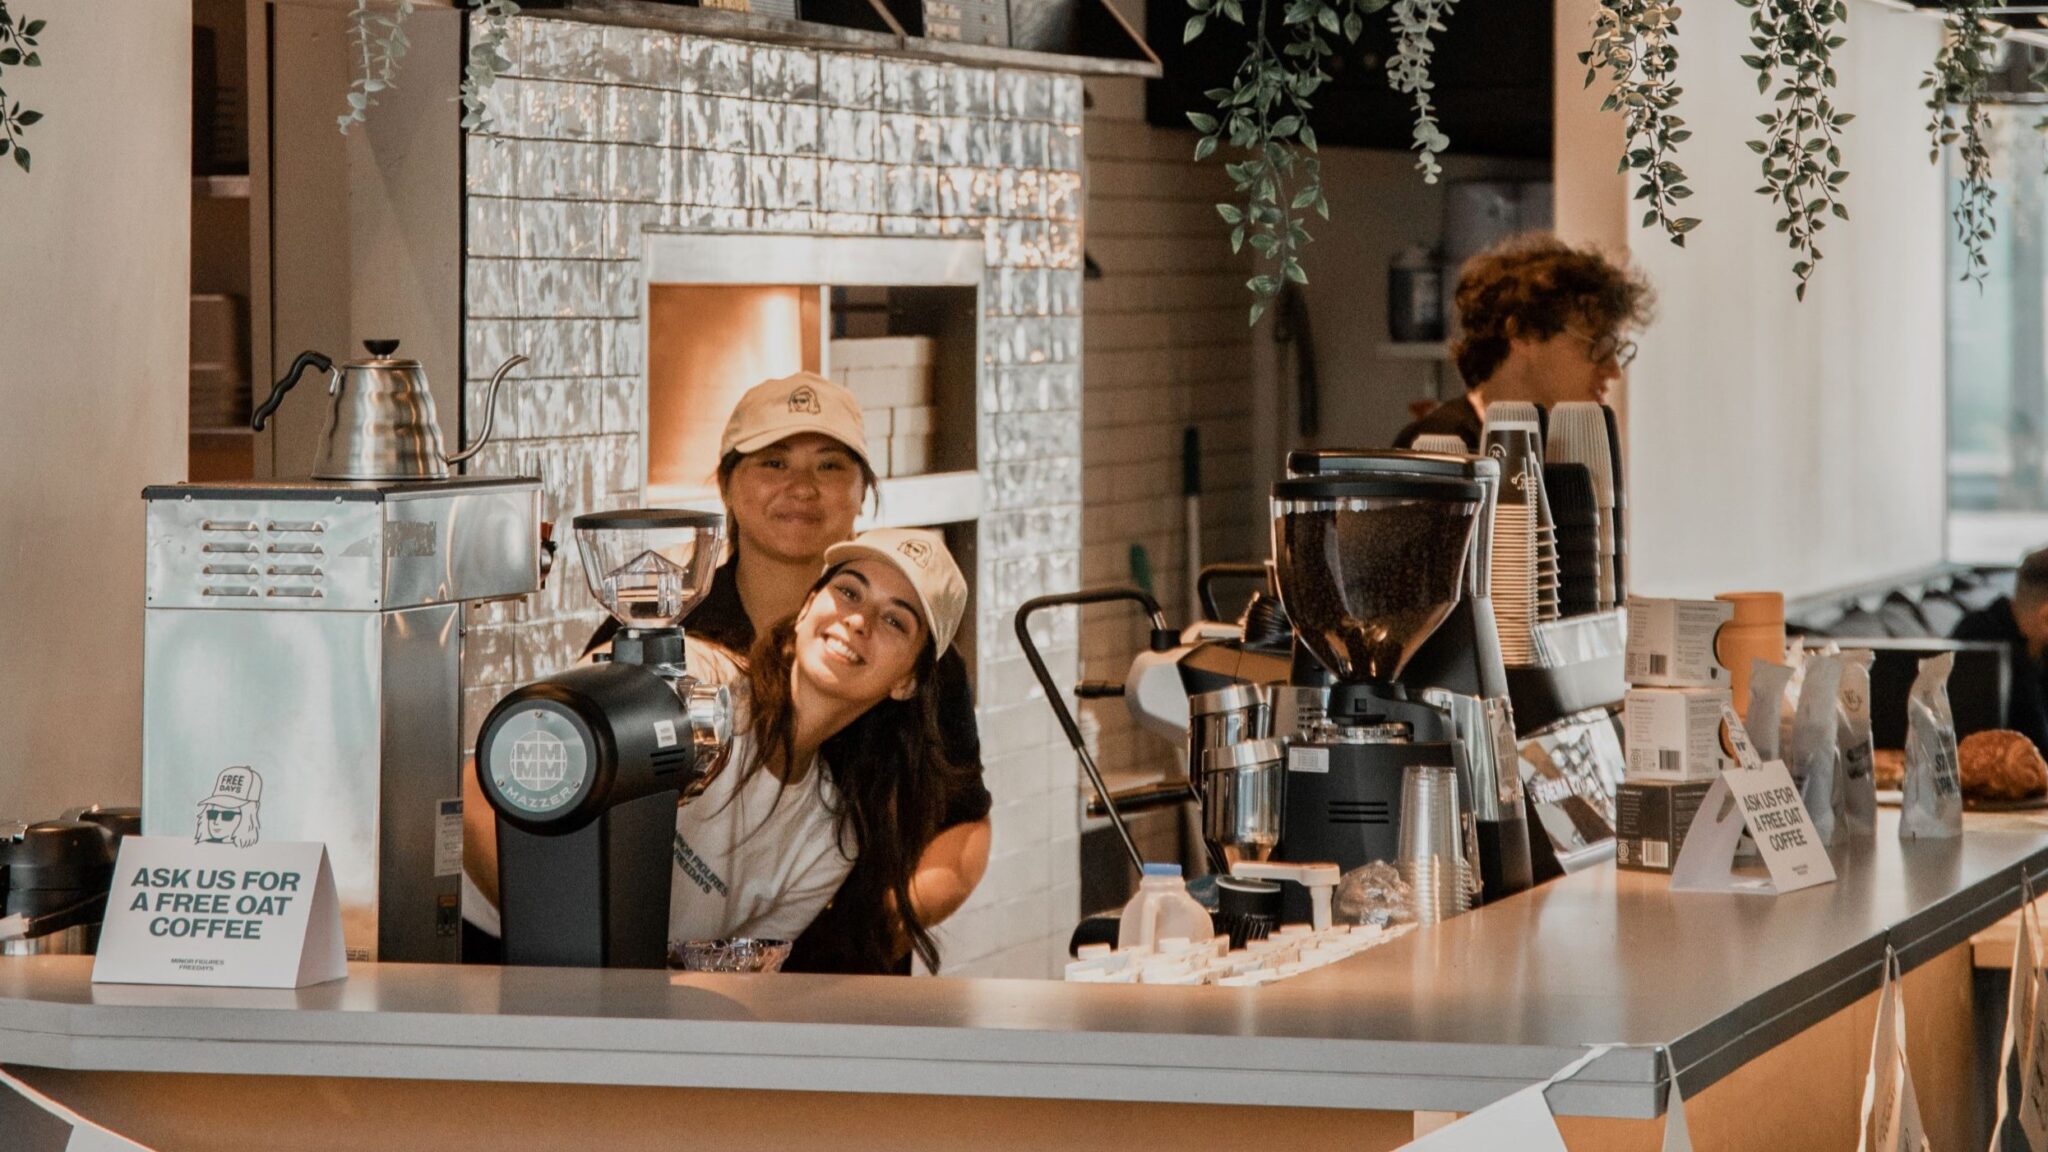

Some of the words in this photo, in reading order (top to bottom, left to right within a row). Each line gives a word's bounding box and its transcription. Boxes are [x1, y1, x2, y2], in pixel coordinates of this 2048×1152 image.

[219, 785, 241, 794] DAYS
[221, 774, 245, 787] FREE
[506, 786, 571, 808] MAZZER
[1743, 793, 1764, 812] ASK
[1760, 790, 1777, 808] US
[1773, 786, 1797, 806] FOR
[1753, 816, 1764, 832] A
[1760, 811, 1787, 832] FREE
[1784, 807, 1804, 826] OAT
[1769, 829, 1808, 852] COFFEE
[131, 867, 192, 888] ASK
[196, 870, 236, 890] US
[241, 871, 301, 892] FOR
[691, 855, 728, 897] FIGURES
[129, 892, 148, 912] A
[155, 893, 231, 914] FREE
[235, 895, 293, 916] OAT
[149, 917, 263, 940] COFFEE
